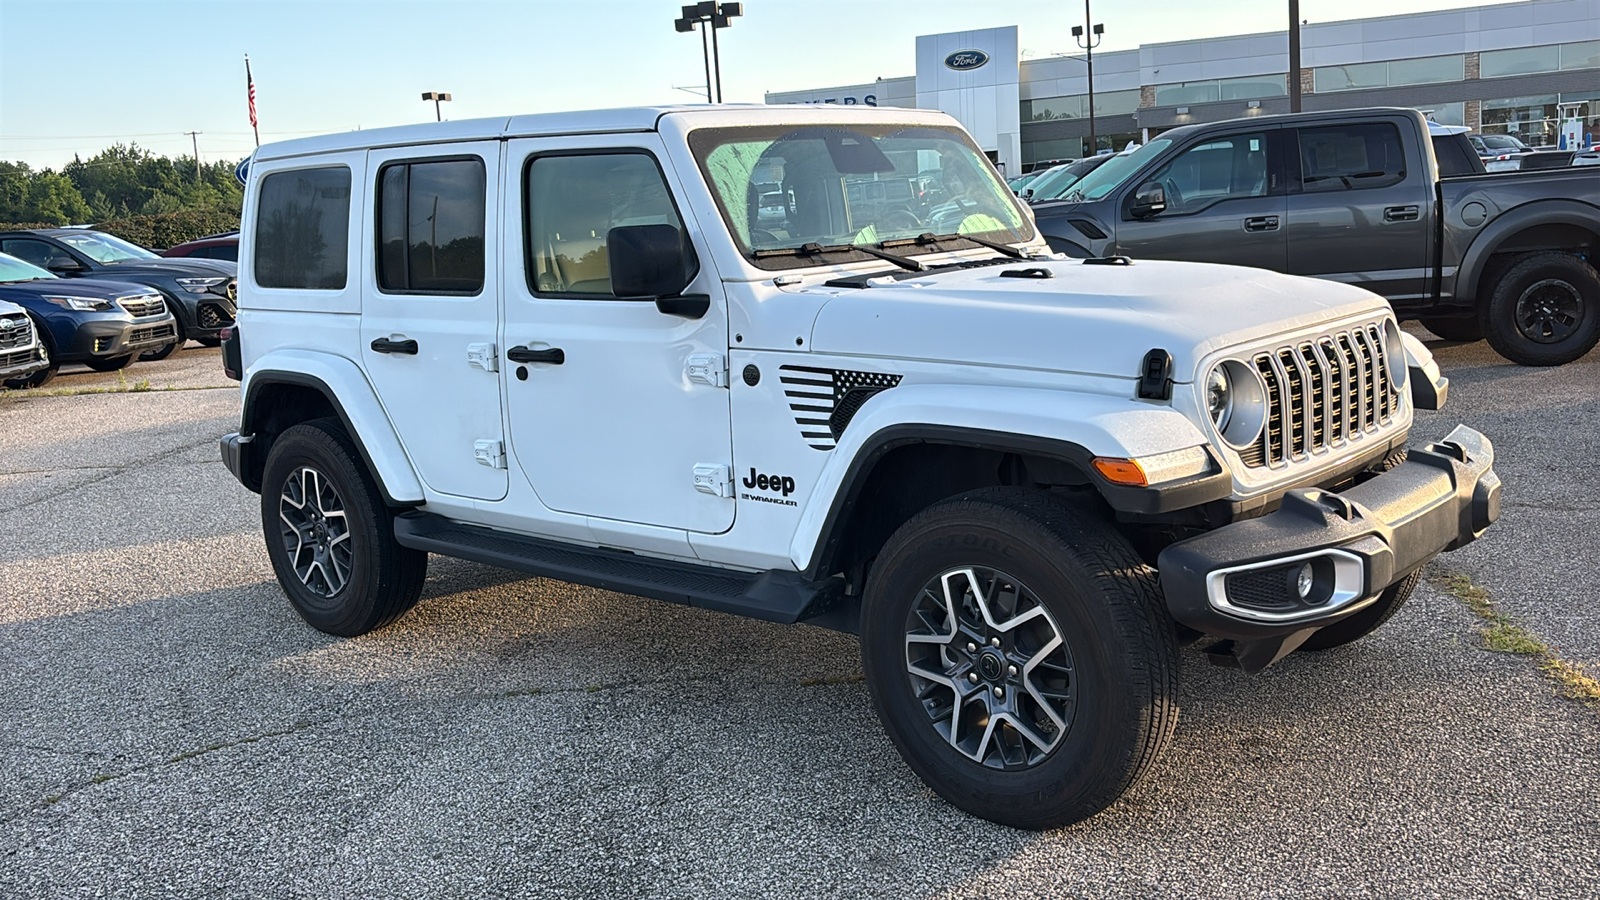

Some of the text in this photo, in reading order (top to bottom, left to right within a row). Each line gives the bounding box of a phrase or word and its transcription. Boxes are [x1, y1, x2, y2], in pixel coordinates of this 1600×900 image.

[953, 54, 978, 66] Ford
[742, 467, 795, 497] Jeep
[749, 494, 798, 507] WRANGLER
